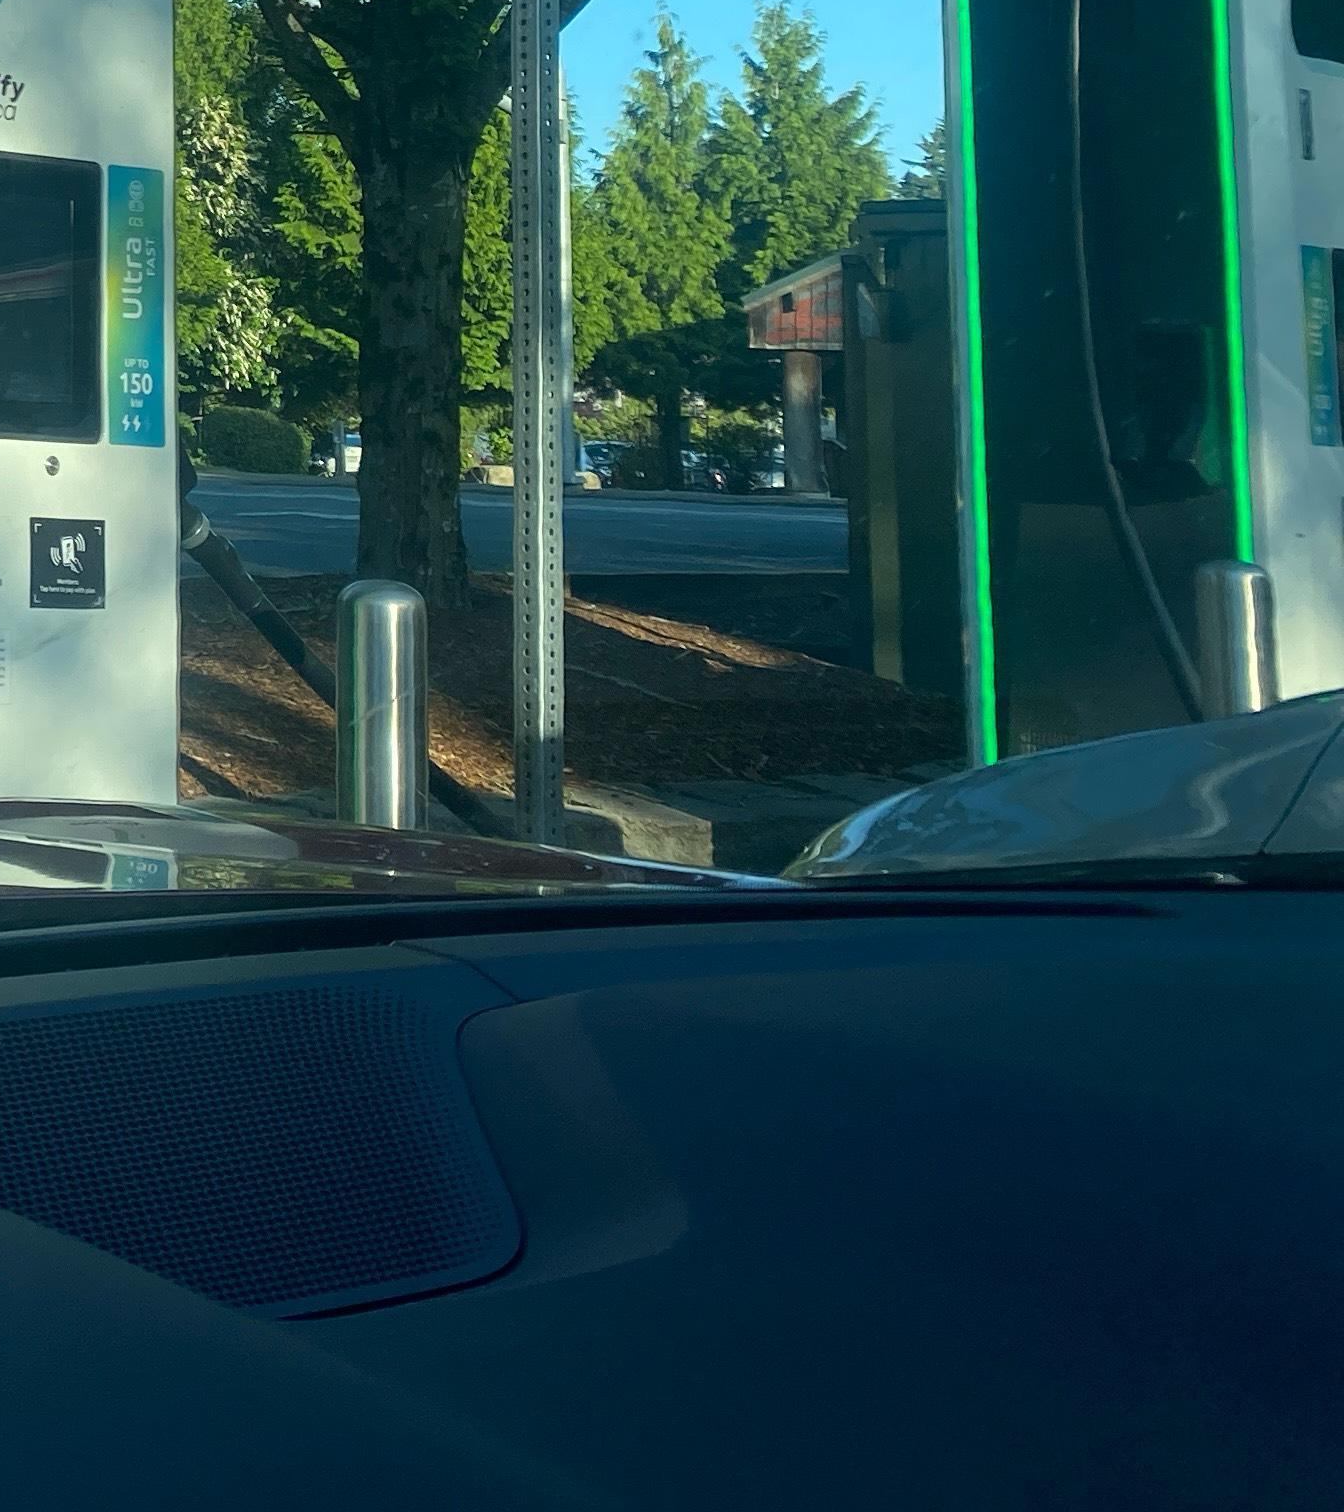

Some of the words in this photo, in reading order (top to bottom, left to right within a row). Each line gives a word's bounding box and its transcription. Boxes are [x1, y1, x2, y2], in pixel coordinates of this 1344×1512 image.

[146, 238, 156, 276] FAST
[122, 237, 143, 320] Ultra
[124, 358, 137, 368] UP
[138, 359, 149, 369] TO
[120, 372, 153, 395] 150
